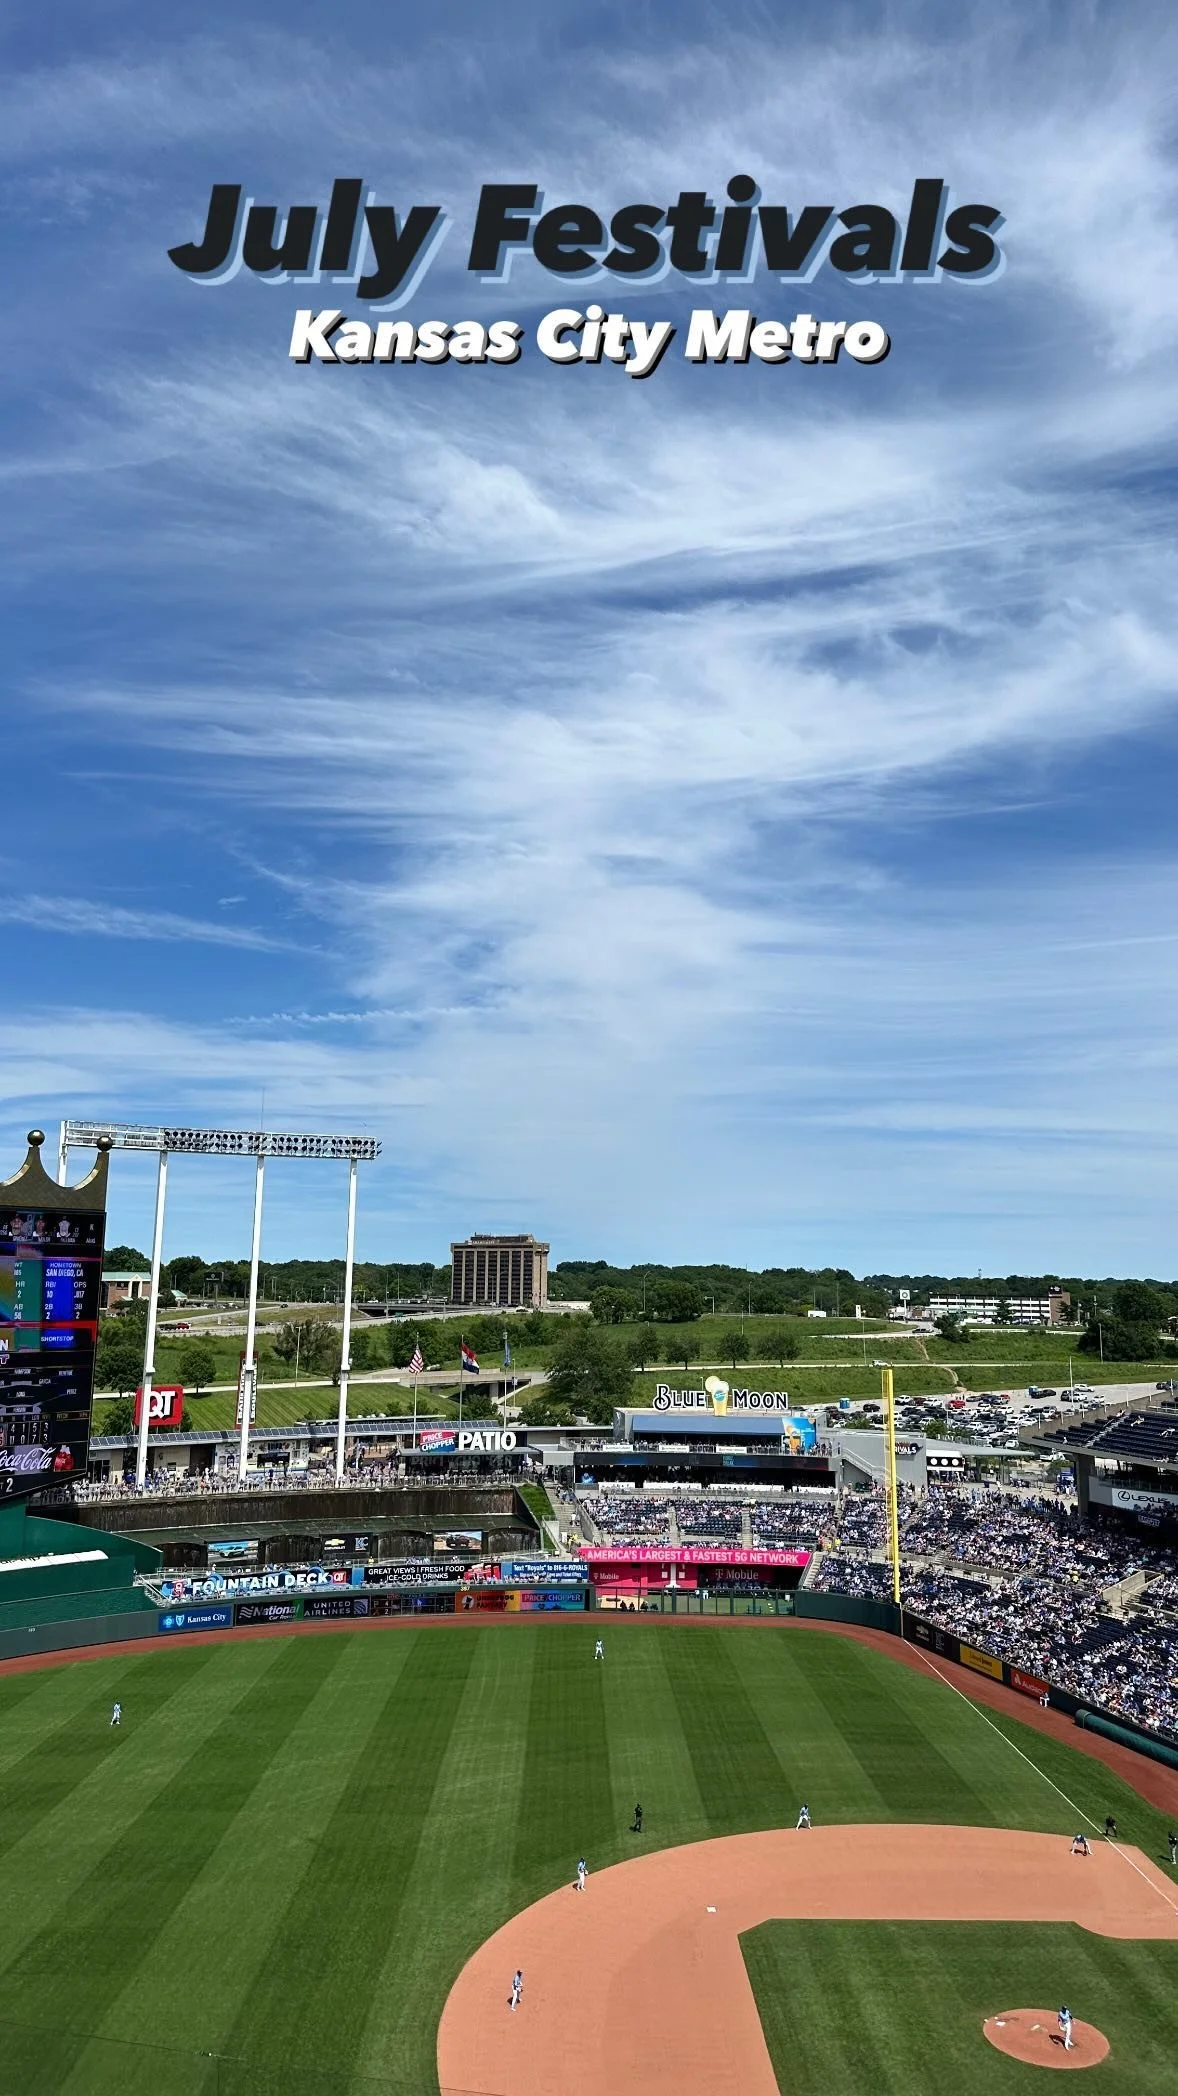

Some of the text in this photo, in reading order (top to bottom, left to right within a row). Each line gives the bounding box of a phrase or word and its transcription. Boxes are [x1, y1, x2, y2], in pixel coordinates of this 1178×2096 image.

[45, 1268, 57, 1277] SAN
[58, 1268, 76, 1278] DIEGO,
[76, 1269, 84, 1277] CA
[17, 1290, 22, 1299] 2
[46, 1290, 54, 1299] 10
[45, 1311, 51, 1320] 2
[75, 1311, 81, 1320] 2
[653, 1384, 788, 1411] BLUE MOON
[148, 1390, 176, 1419] QT
[421, 1438, 455, 1452] CHOPPER
[422, 1431, 517, 1451] PRICE PATIO
[5, 1477, 14, 1493] 2
[1131, 1494, 1168, 1504] LEXUS
[587, 1549, 799, 1564] AMERICA'S LARGEST & FASTEST 5G NETWORK
[368, 1567, 392, 1575] GREAT
[393, 1566, 416, 1574] VIEWS
[420, 1565, 444, 1573] FRESH
[525, 1564, 547, 1573] "Royals"
[725, 1568, 759, 1580] Mobile
[386, 1572, 449, 1581] ICE-COLD DRINKS
[599, 1572, 619, 1580] Mobile
[192, 1571, 345, 1597] FOUNTAIN DECK QT
[313, 1600, 351, 1609] UNITED
[252, 1604, 300, 1617] National
[303, 1607, 351, 1617] AIRLINES
[187, 1612, 228, 1624] Kansas City
